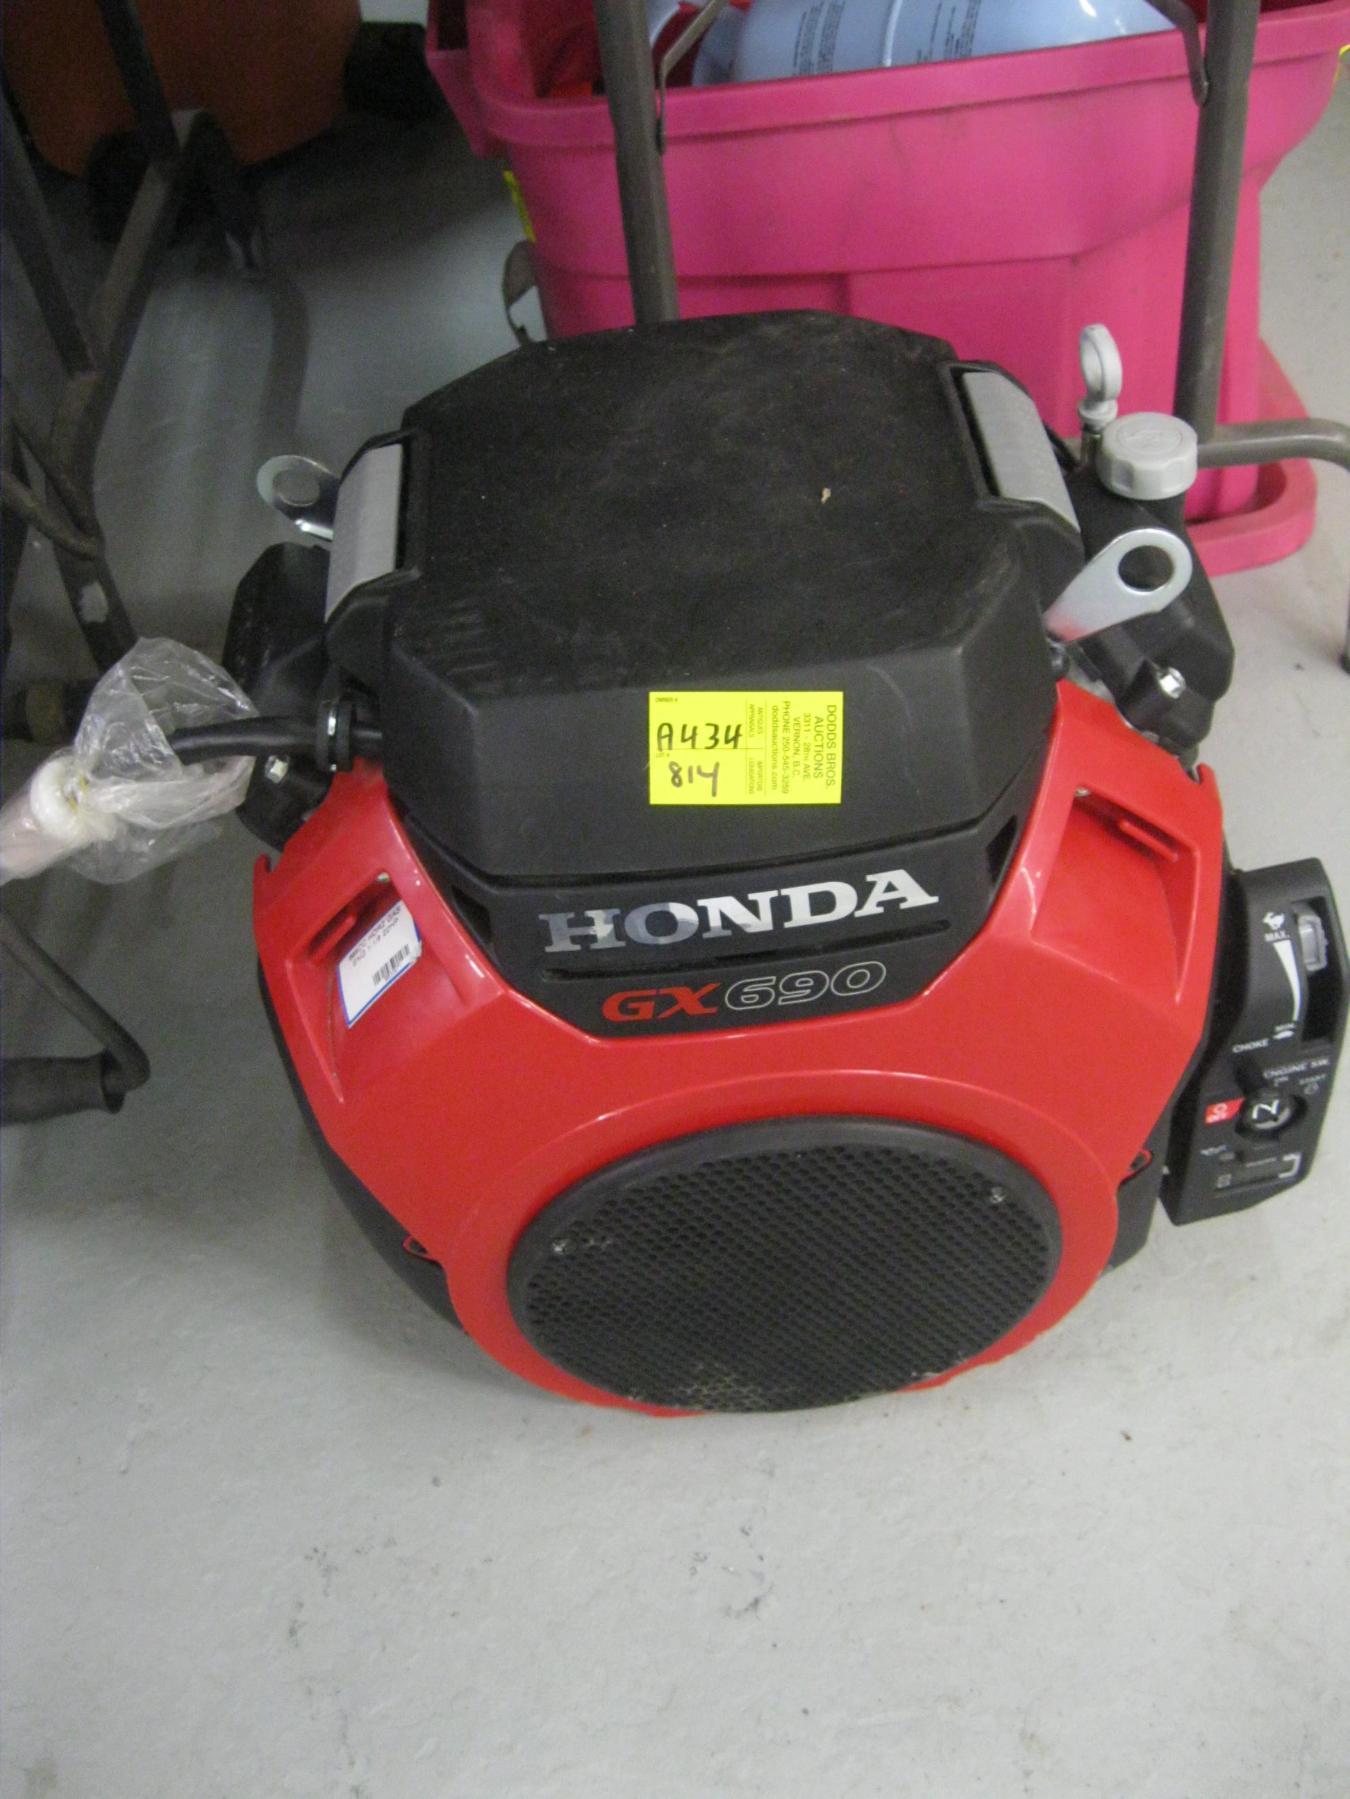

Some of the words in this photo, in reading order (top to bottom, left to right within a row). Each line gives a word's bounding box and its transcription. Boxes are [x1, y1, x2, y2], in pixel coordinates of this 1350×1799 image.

[782, 700, 791, 734] PHONE
[826, 704, 838, 750] DODDS
[656, 722, 743, 752] A434
[813, 715, 825, 779] AUCTIONS
[668, 760, 720, 797] 814
[824, 752, 837, 790] BROS.
[538, 868, 940, 953] HONDA
[1264, 930, 1291, 942] MAX.
[1232, 1038, 1270, 1054] CHOKE
